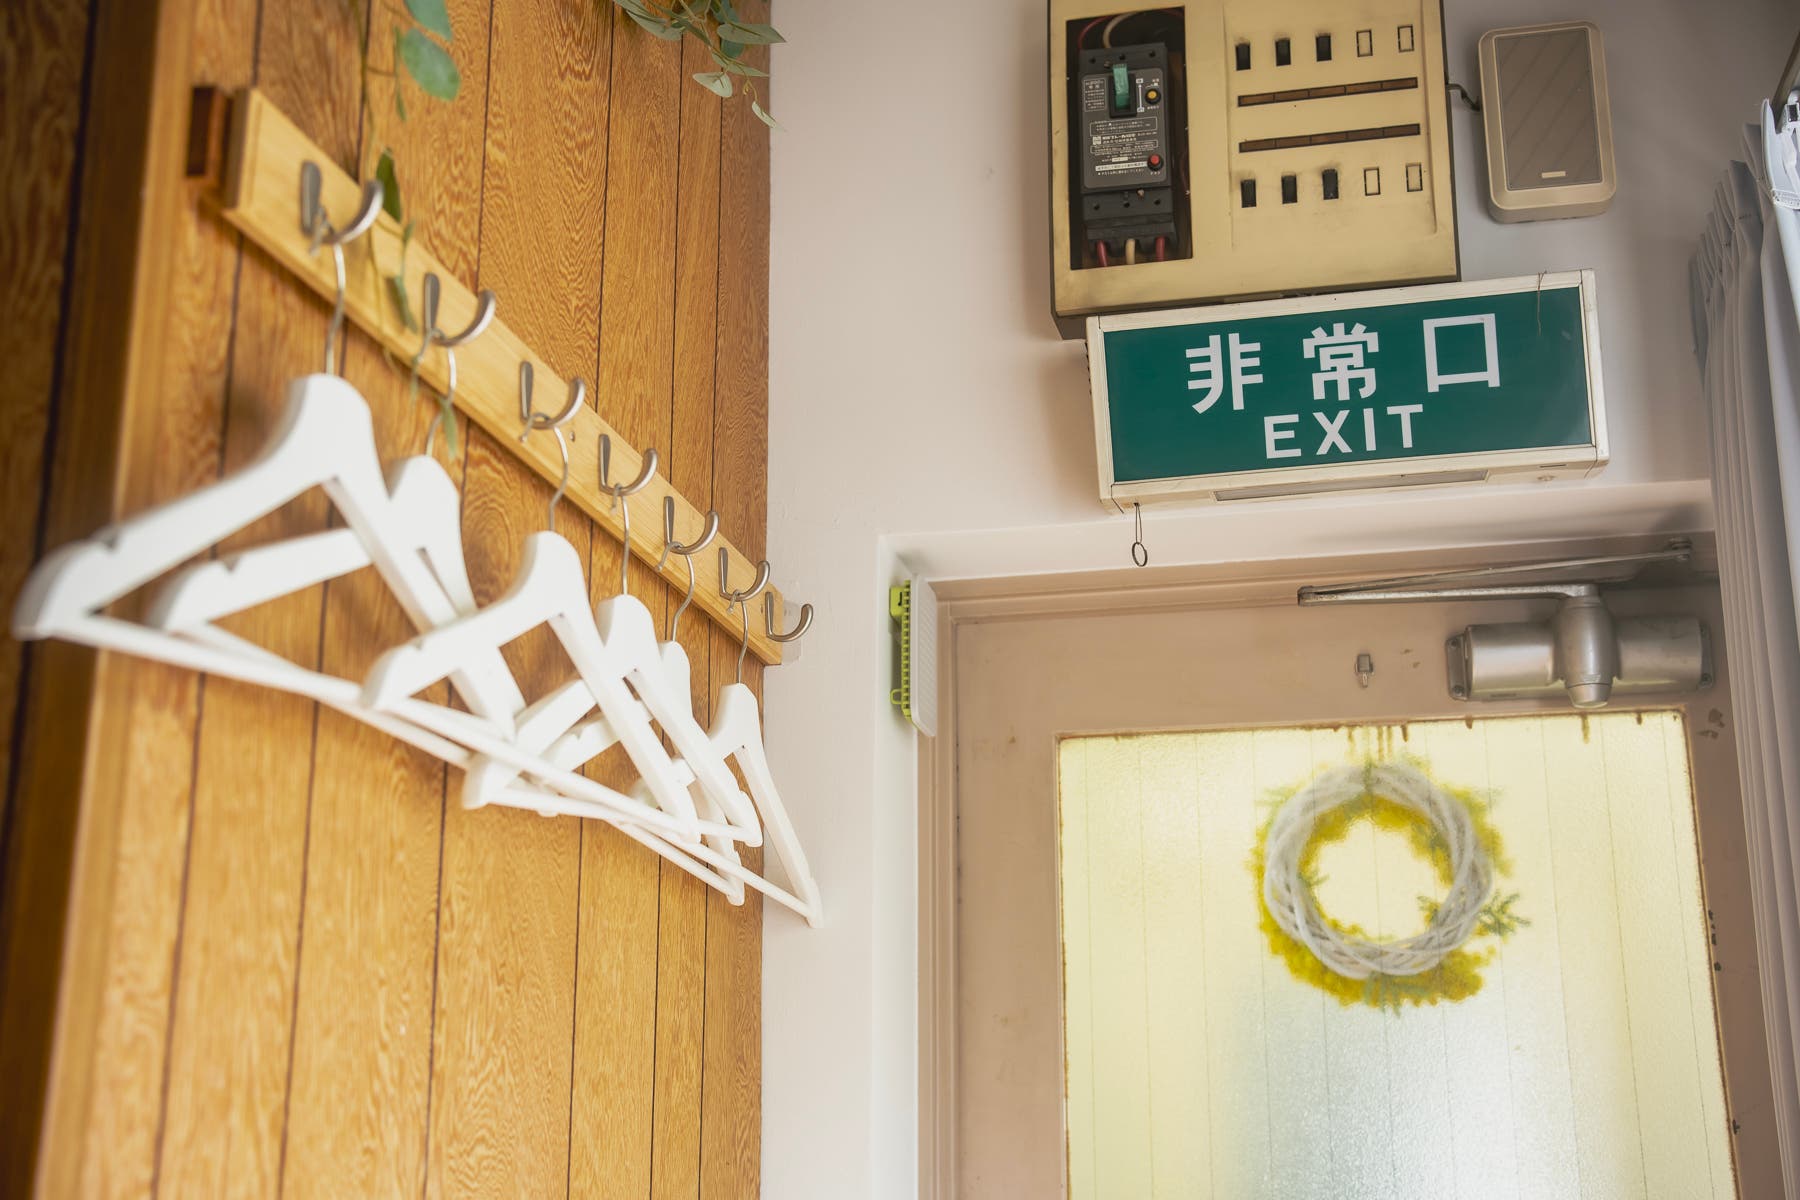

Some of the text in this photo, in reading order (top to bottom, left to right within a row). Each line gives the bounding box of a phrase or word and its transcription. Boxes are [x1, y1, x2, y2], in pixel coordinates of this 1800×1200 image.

[1185, 313, 1500, 414] 非常口
[1263, 403, 1424, 459] EXIT
